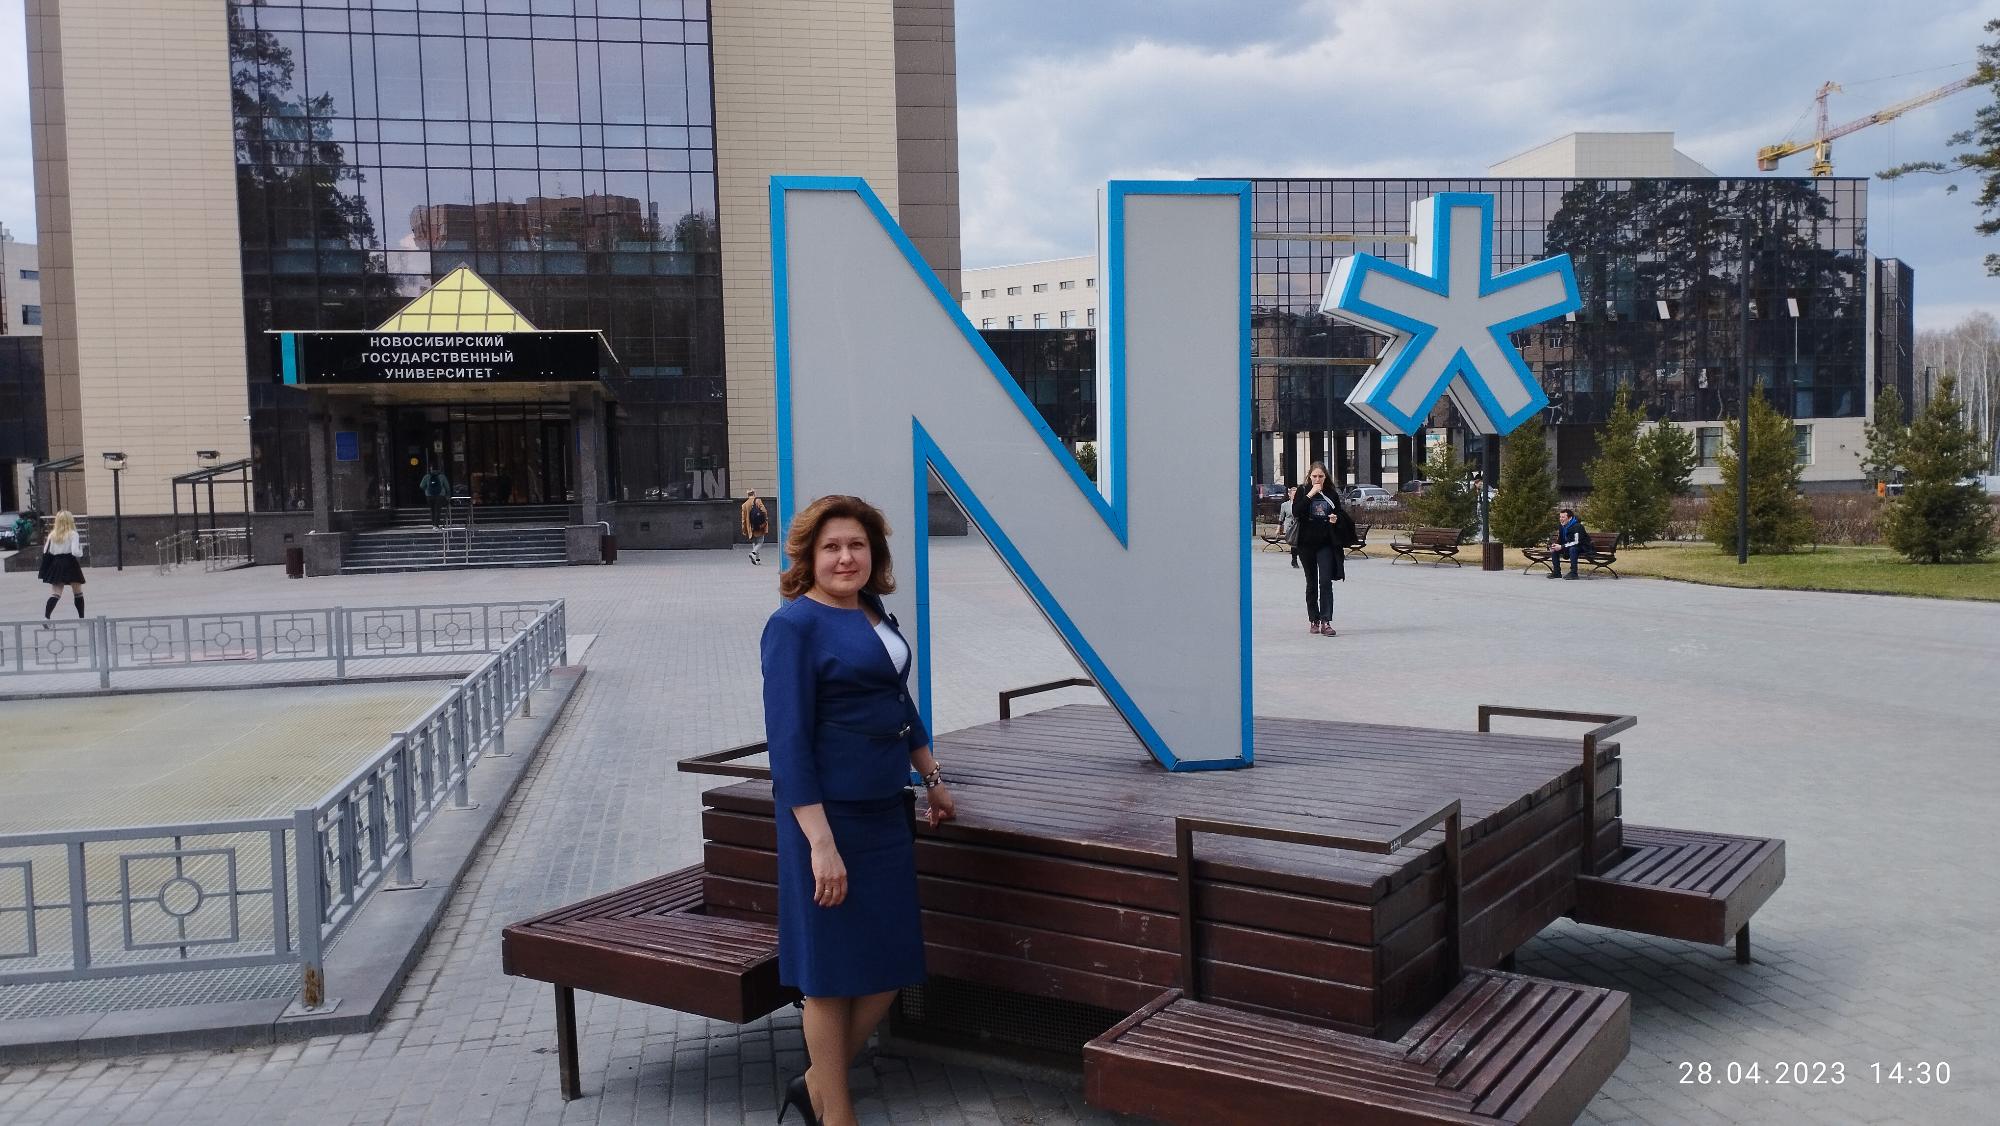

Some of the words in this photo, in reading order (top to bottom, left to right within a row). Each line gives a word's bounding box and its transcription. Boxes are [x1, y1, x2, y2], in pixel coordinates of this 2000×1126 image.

[370, 335, 504, 347] НОВОСИБИРСКИЙ
[361, 350, 514, 365] ГОСУДАРСТВЕННЫЙ
[385, 368, 493, 379] УНИВЕРСИТЕТ
